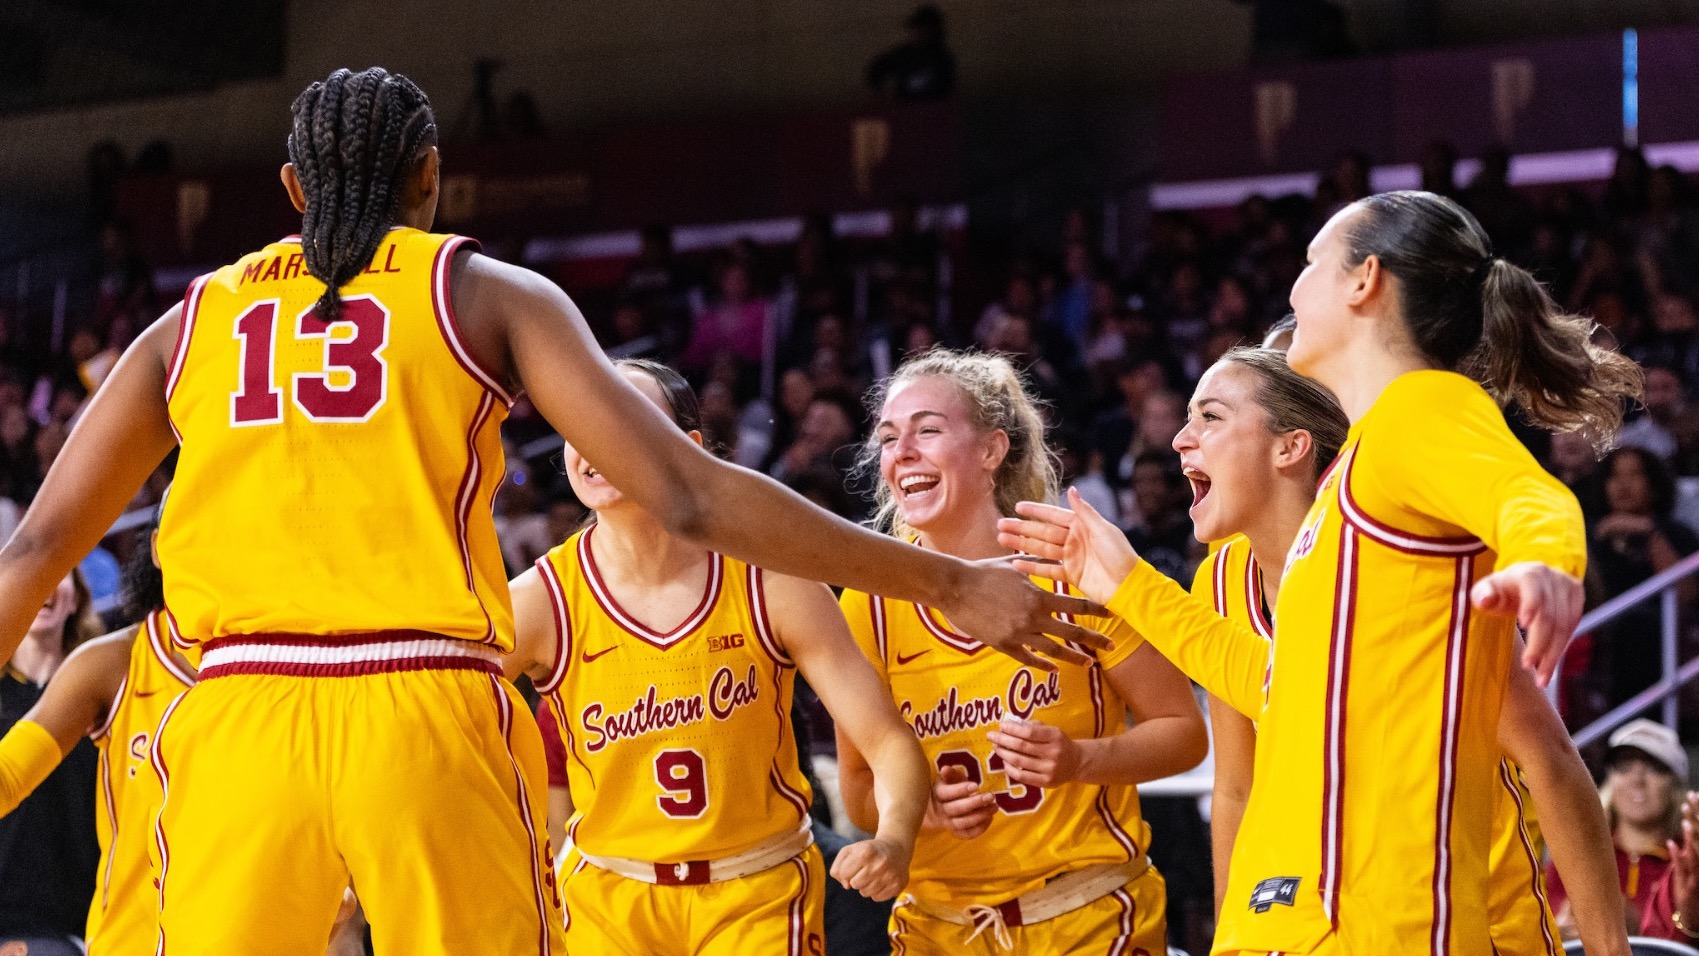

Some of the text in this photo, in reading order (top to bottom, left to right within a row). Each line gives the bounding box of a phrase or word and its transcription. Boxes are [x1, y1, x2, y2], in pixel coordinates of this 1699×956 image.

[239, 244, 401, 286] MARL
[229, 293, 391, 428] 13
[582, 664, 759, 756] Southern Cal
[1007, 666, 1061, 722] Cal
[653, 748, 709, 819] 9
